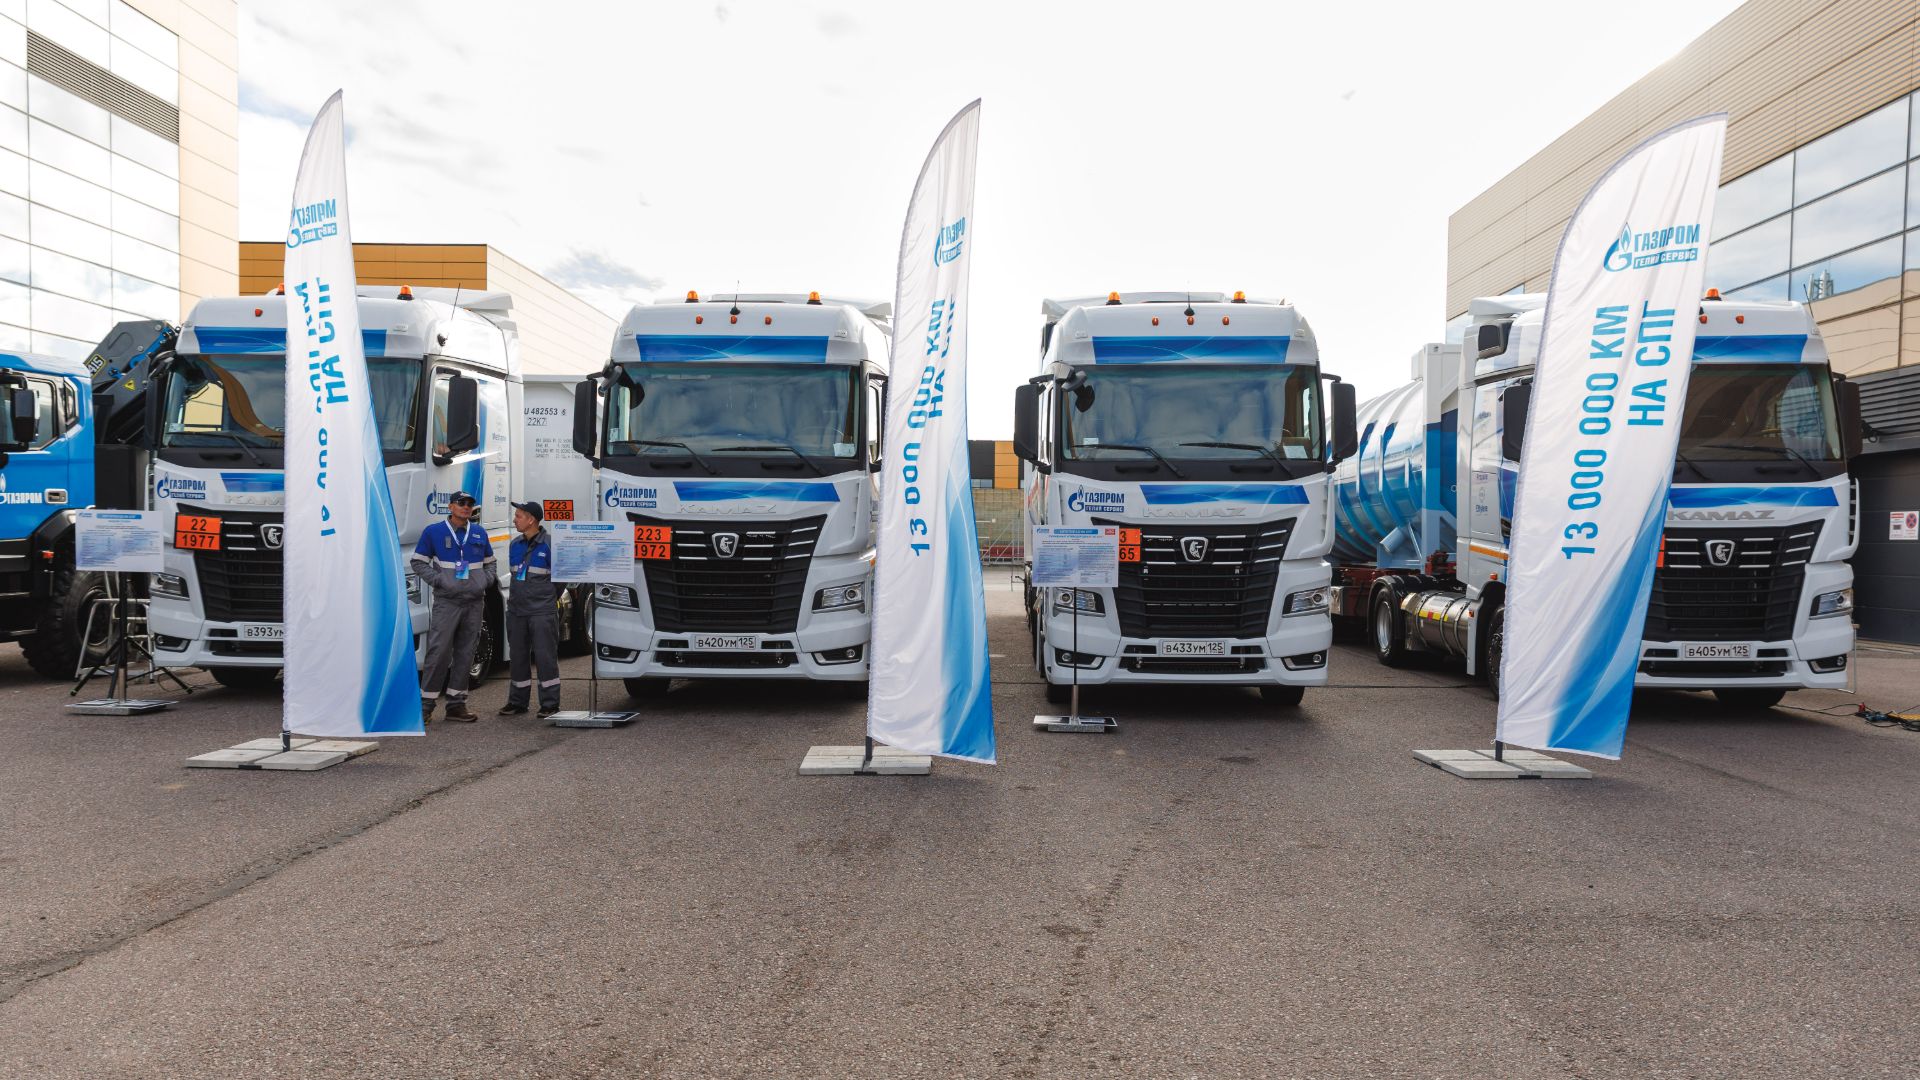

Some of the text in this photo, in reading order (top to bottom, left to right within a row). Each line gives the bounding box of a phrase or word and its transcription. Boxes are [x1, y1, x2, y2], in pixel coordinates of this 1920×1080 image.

[1634, 224, 1700, 252] ГАЗПРОМ
[1660, 249, 1697, 262] СЕРВИС
[1627, 300, 1676, 426] НА СПГ
[321, 355, 349, 404] НА
[530, 407, 558, 416] 482553
[1561, 305, 1629, 560] 13 000 000 КМ
[169, 479, 206, 491] ГАЗПРОМ
[7, 492, 43, 504] ГАЗПРОМ
[620, 488, 657, 499] ГАЗПРОМ
[1085, 492, 1125, 504] ГАЗПРОМ
[549, 501, 568, 510] 223
[547, 511, 571, 520] 1038
[1667, 510, 1776, 520] KAMAZ
[191, 519, 207, 532] 22
[637, 528, 662, 541] 223
[910, 518, 930, 557] 13
[182, 535, 215, 548] 1977
[634, 544, 666, 558] 1972
[738, 637, 754, 646] 125
[1207, 642, 1223, 651] 125
[1732, 645, 1748, 654] 125
